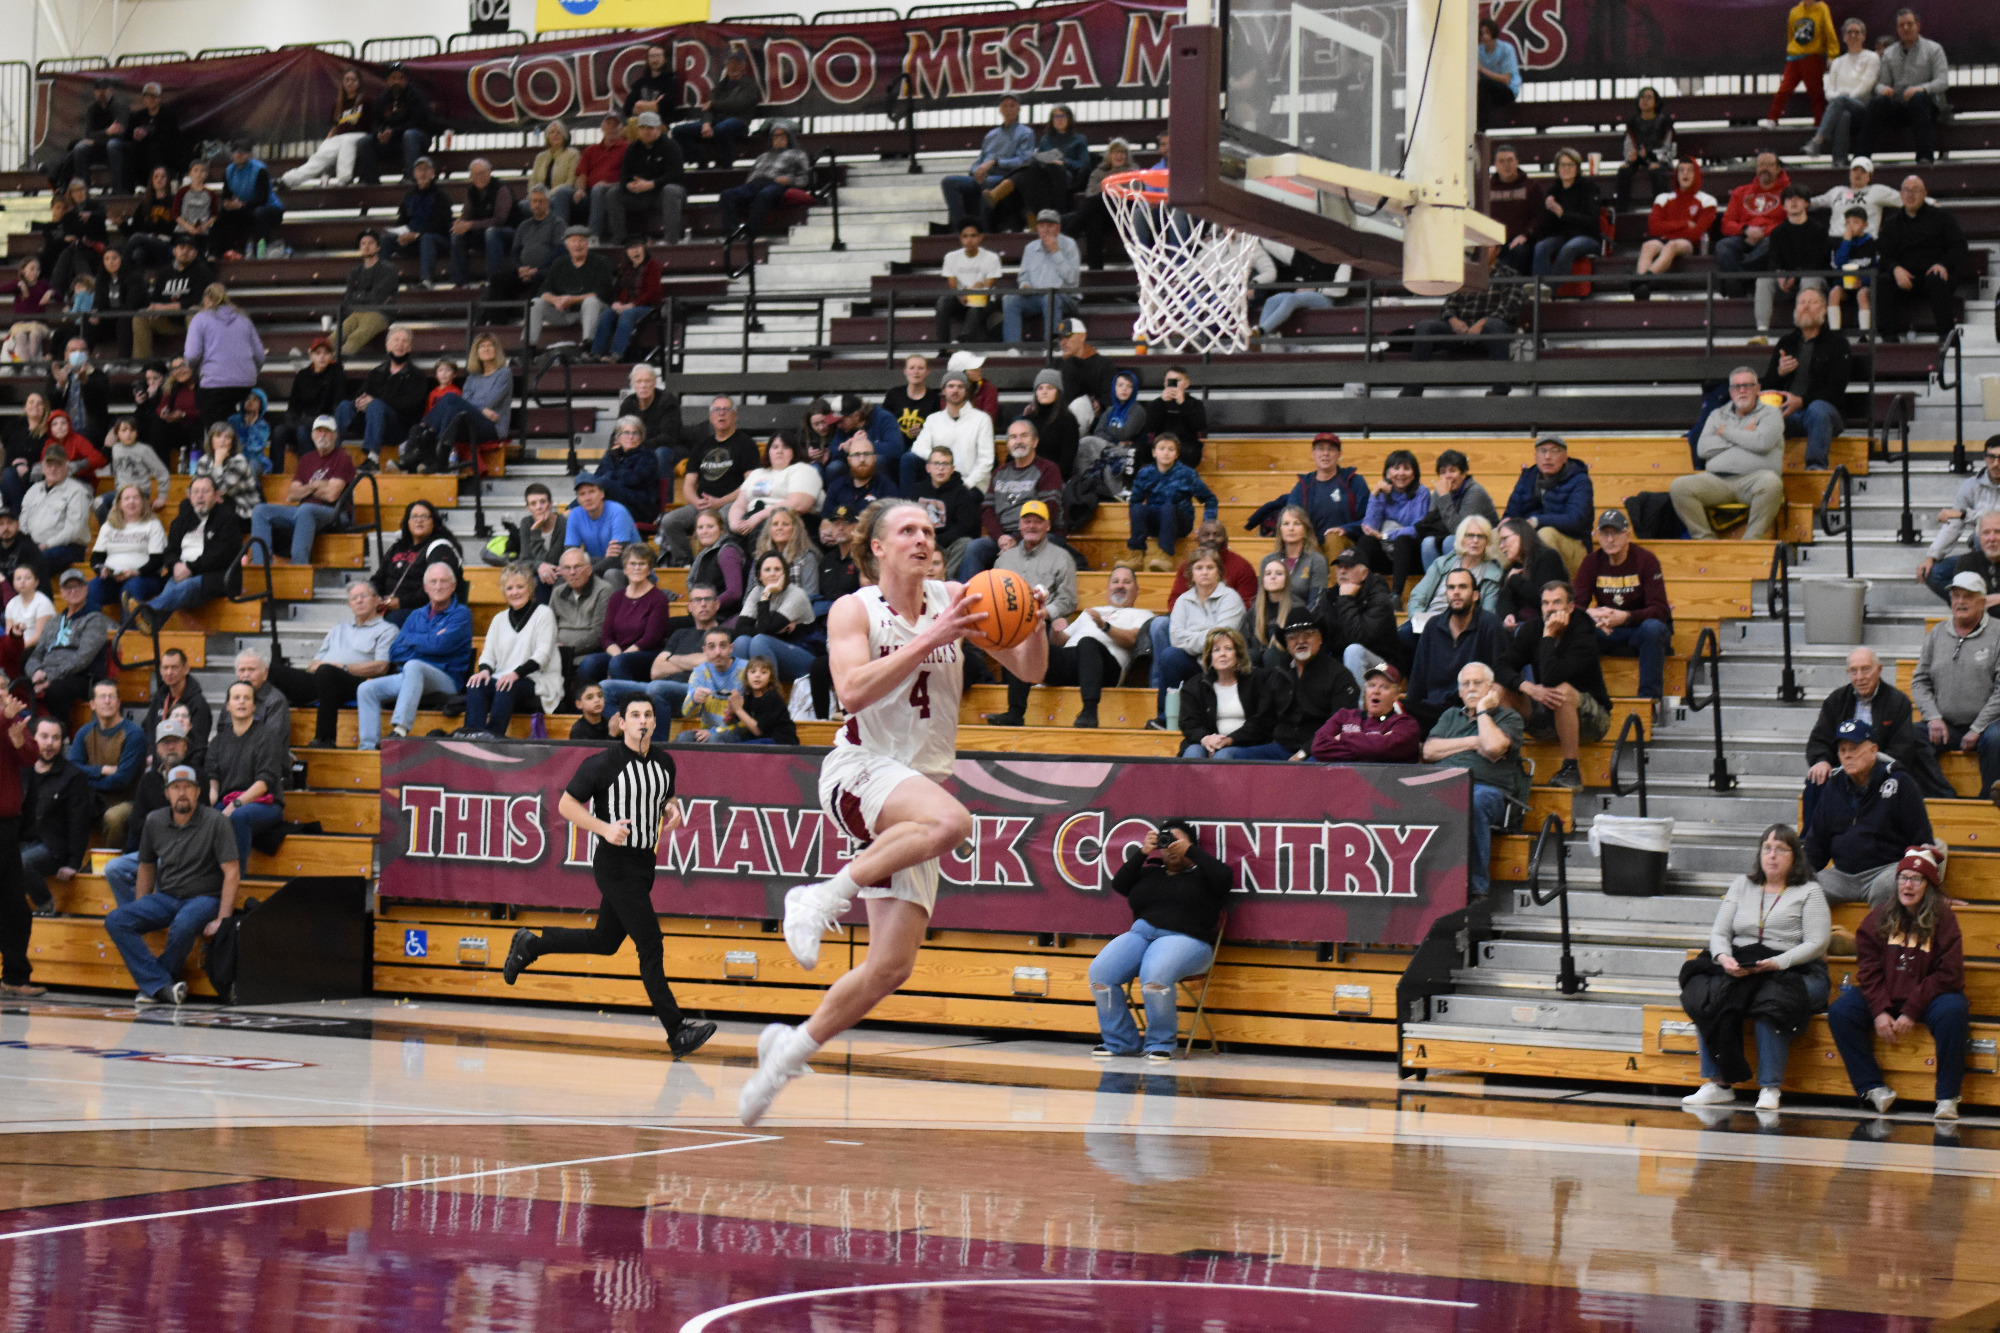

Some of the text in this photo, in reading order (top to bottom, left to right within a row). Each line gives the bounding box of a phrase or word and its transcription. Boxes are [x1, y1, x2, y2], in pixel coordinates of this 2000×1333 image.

[898, 23, 1101, 99] MESA
[1858, 481, 1867, 492] N
[1830, 514, 1841, 525] M
[1002, 577, 1018, 612] NCAA
[909, 670, 931, 719] 4
[1676, 709, 1686, 721] H
[402, 785, 546, 864] THIS
[1052, 811, 1440, 898] CONTRY
[1519, 895, 1531, 908] D
[1483, 947, 1495, 960] C
[1437, 1001, 1448, 1014] B
[1415, 1045, 1638, 1071] A A
